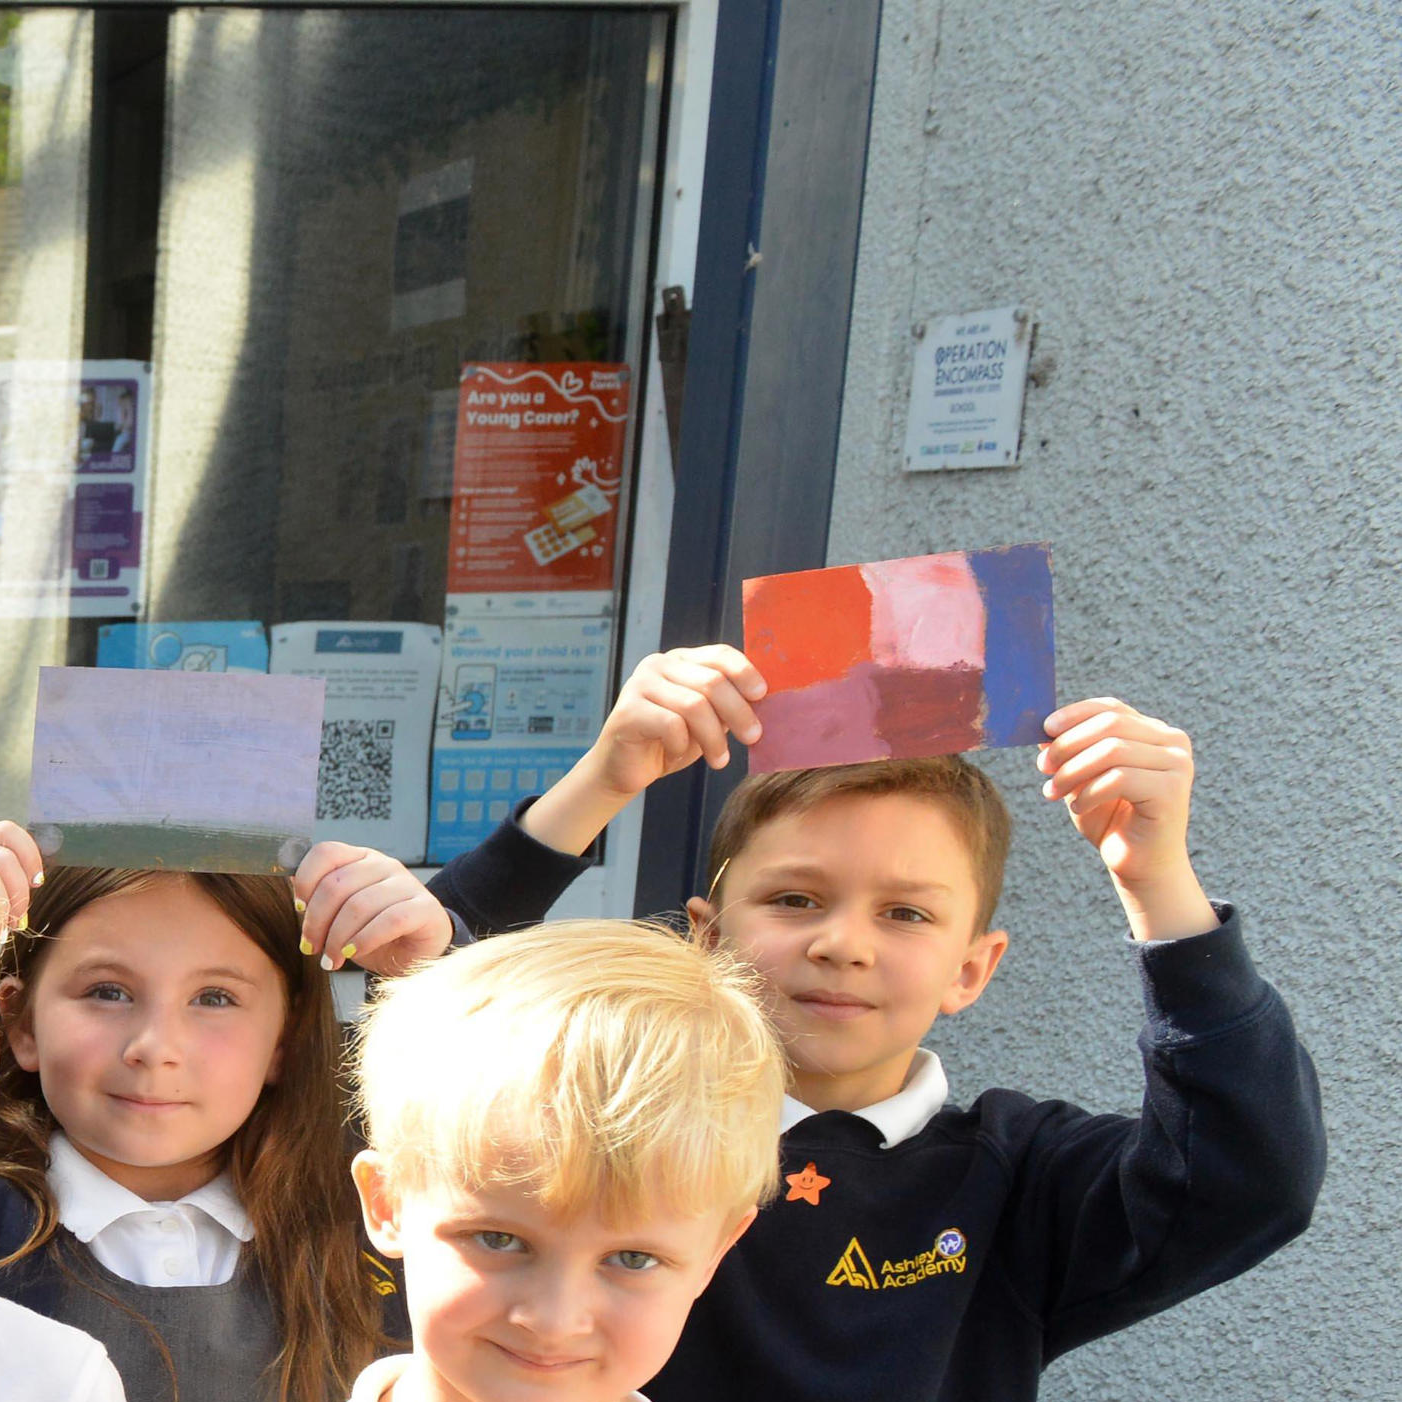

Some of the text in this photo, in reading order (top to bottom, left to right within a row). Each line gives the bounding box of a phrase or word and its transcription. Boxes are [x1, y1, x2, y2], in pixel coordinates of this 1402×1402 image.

[935, 338, 1009, 366] OPERATION
[935, 361, 1005, 386] ENCOMPASS
[467, 390, 546, 408] Are you a
[467, 409, 580, 429] Young Carer?
[881, 1248, 938, 1275] Ashley
[882, 1256, 967, 1289] Academy
